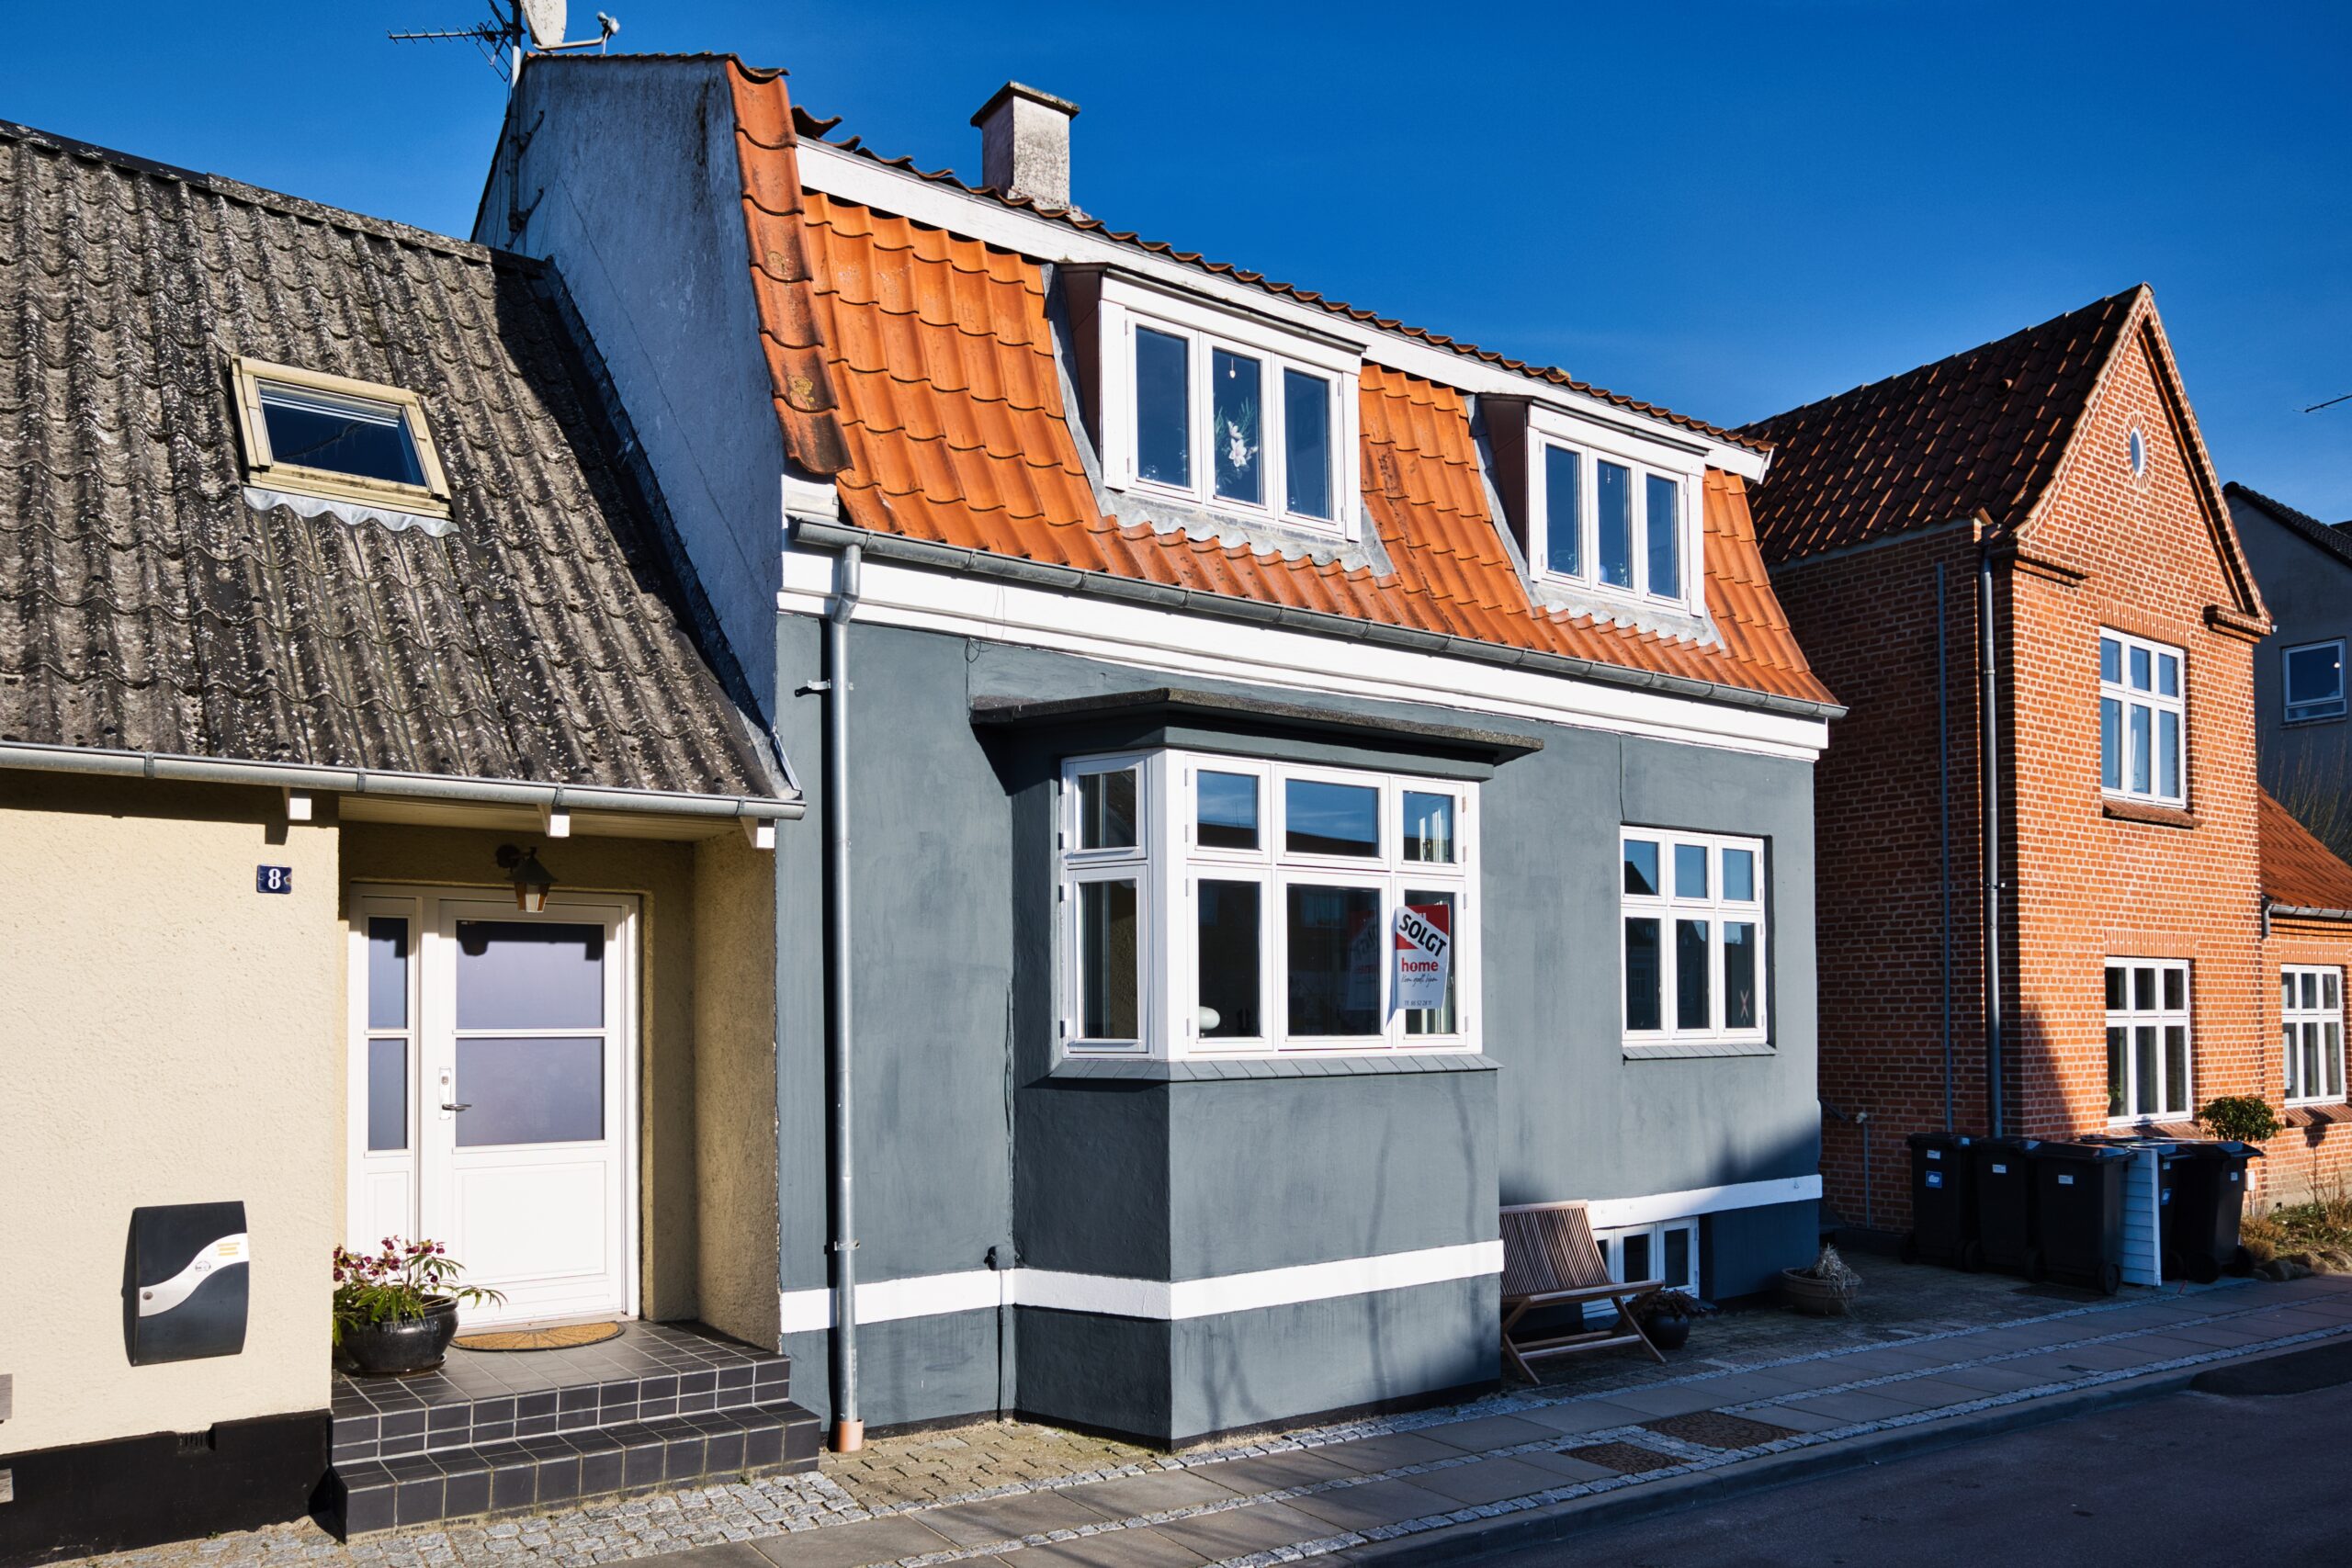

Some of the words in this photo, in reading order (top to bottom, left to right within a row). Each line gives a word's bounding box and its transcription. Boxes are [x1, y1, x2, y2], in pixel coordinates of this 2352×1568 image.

[268, 868, 281, 890] 8
[1398, 913, 1447, 957] SOLGT
[1401, 957, 1439, 972] home
